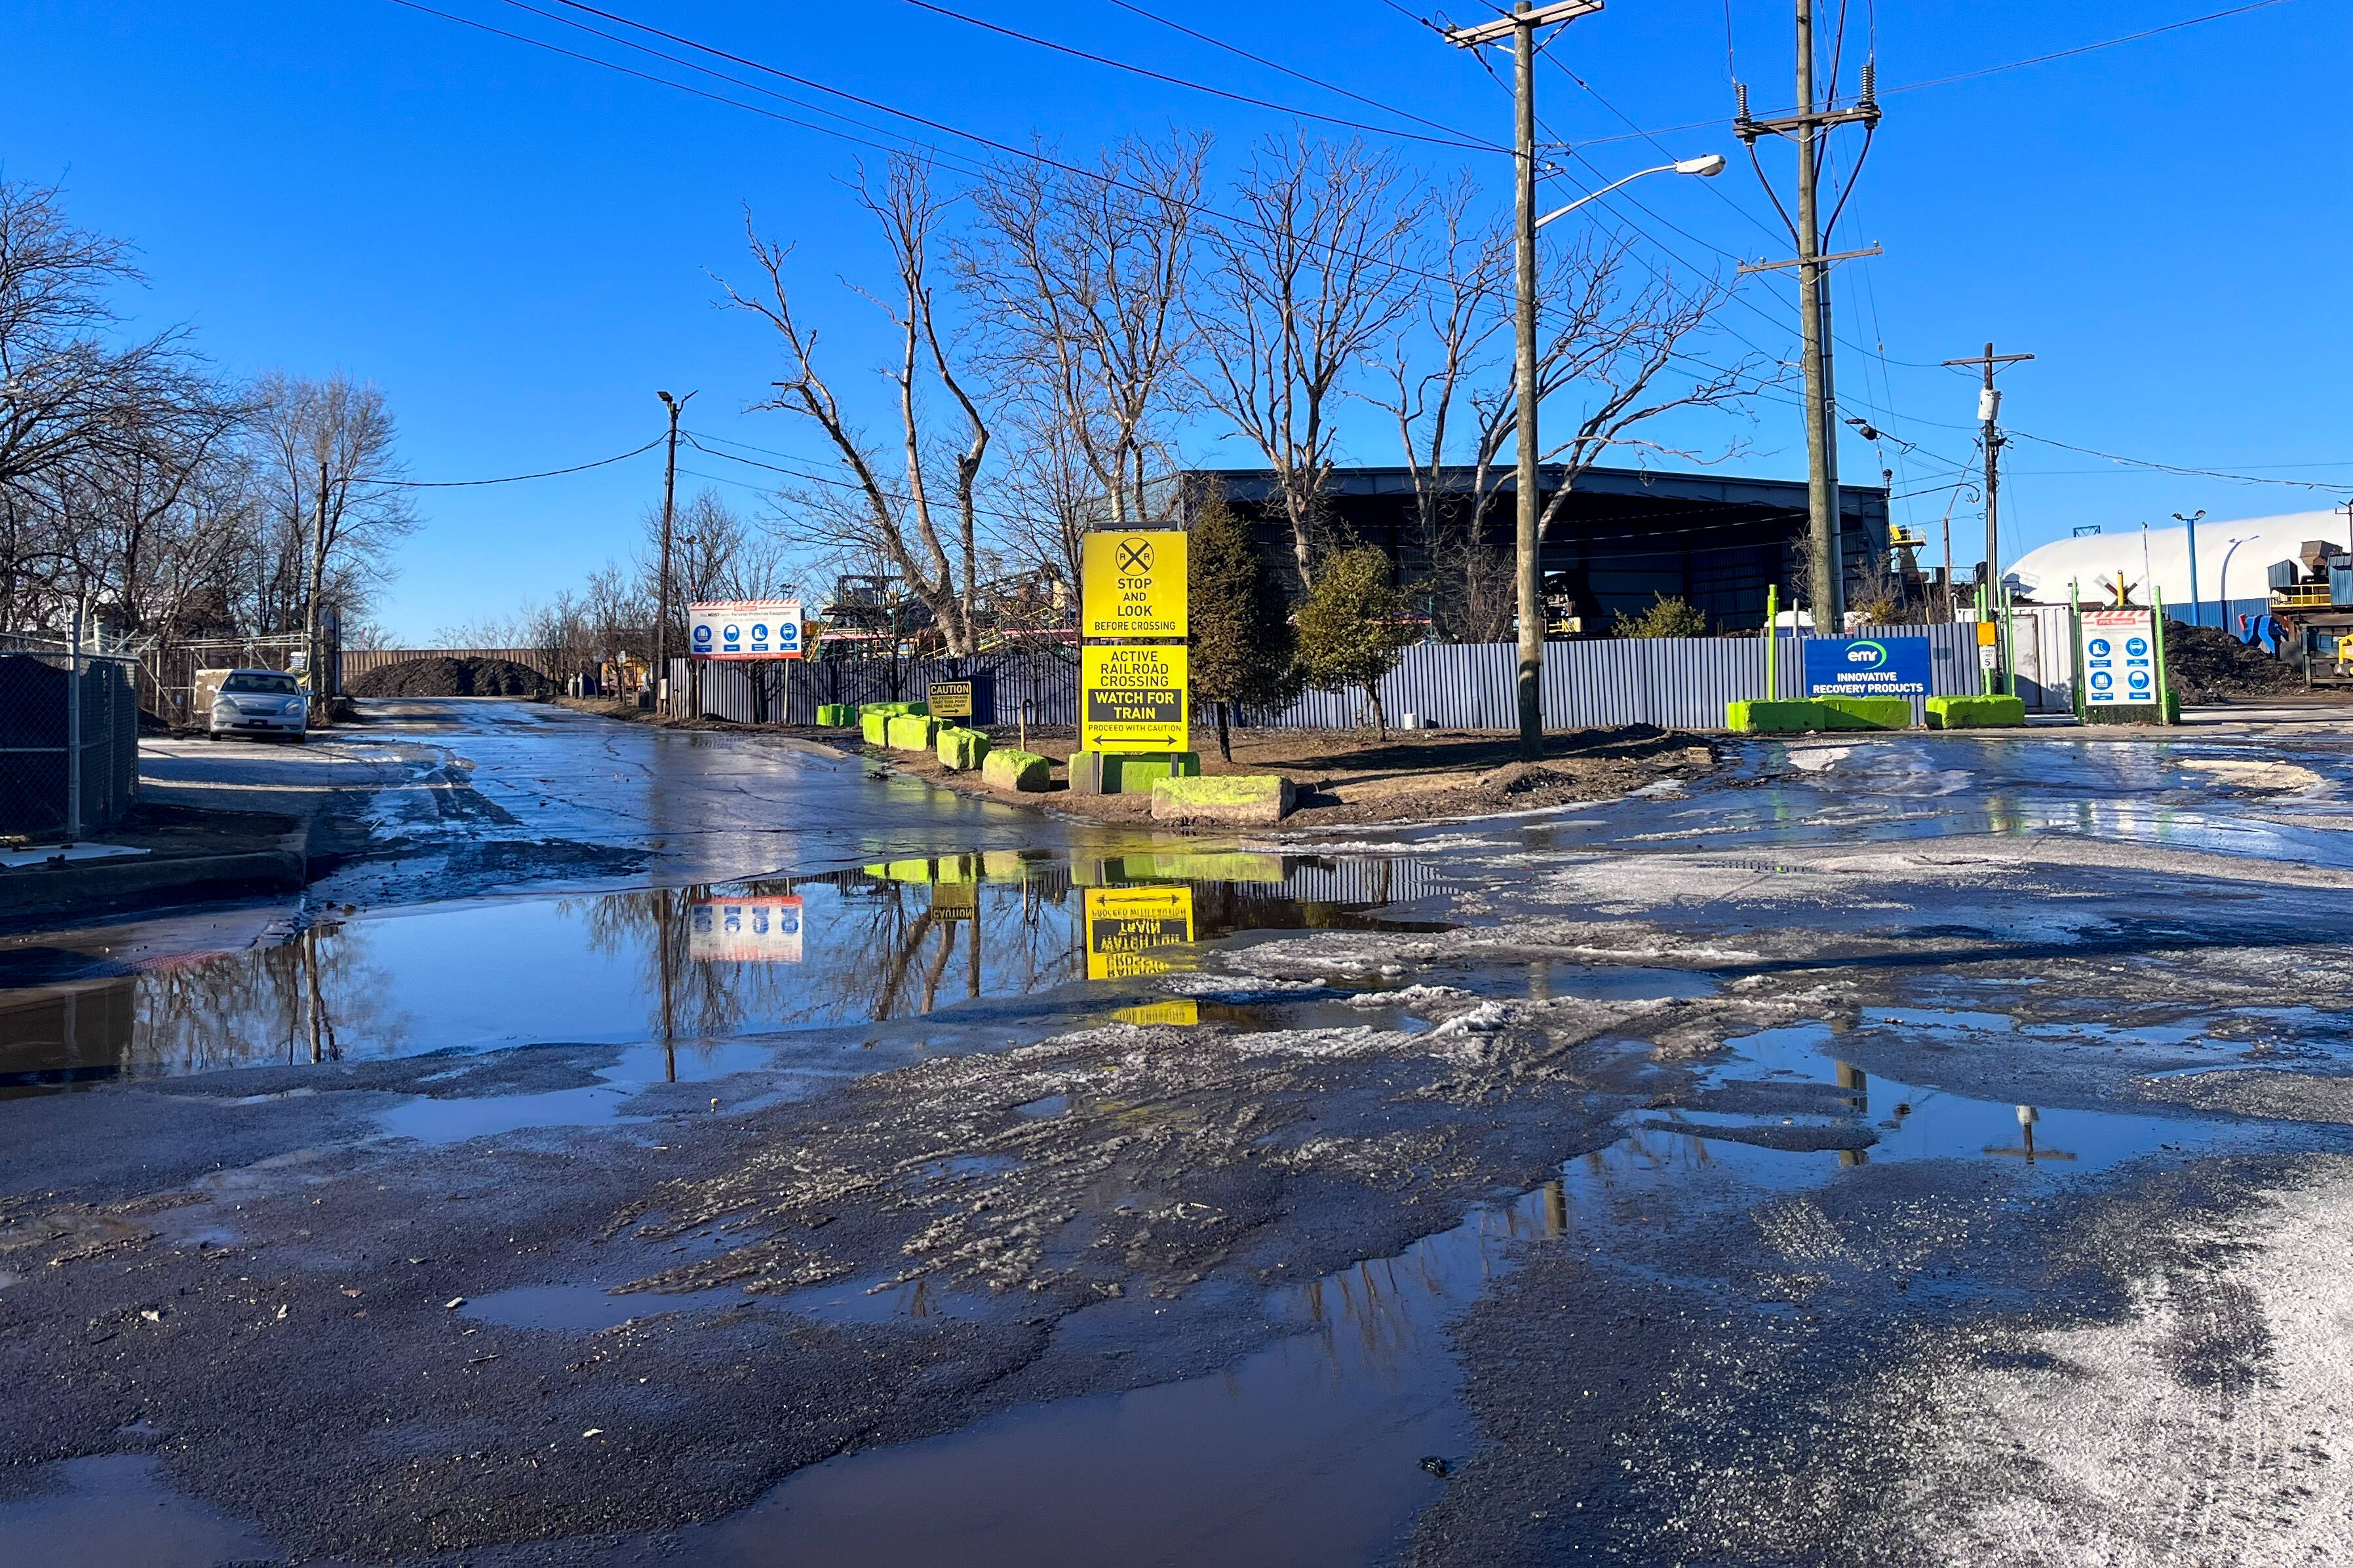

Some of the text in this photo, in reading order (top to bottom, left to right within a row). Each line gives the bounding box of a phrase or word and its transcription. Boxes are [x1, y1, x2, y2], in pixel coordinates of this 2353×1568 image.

[1118, 578, 1152, 589] STOP
[1123, 592, 1146, 602] AND
[1118, 605, 1153, 617] LOOK
[1095, 621, 1175, 631] BEFORE CROSSING
[1110, 651, 1158, 662] ACTIVE
[1847, 650, 1878, 662] emr
[1985, 658, 1991, 666] 5
[1100, 663, 1169, 674] RAILROAD
[1100, 676, 1169, 687] CROSSING
[1837, 672, 1897, 682] INNOVATIVE
[931, 685, 969, 695] CAUTION
[1813, 683, 1924, 694] RECOVERY PRODUCTS
[1095, 691, 1175, 704] WATCH FOR
[1113, 706, 1156, 719] TRAIN
